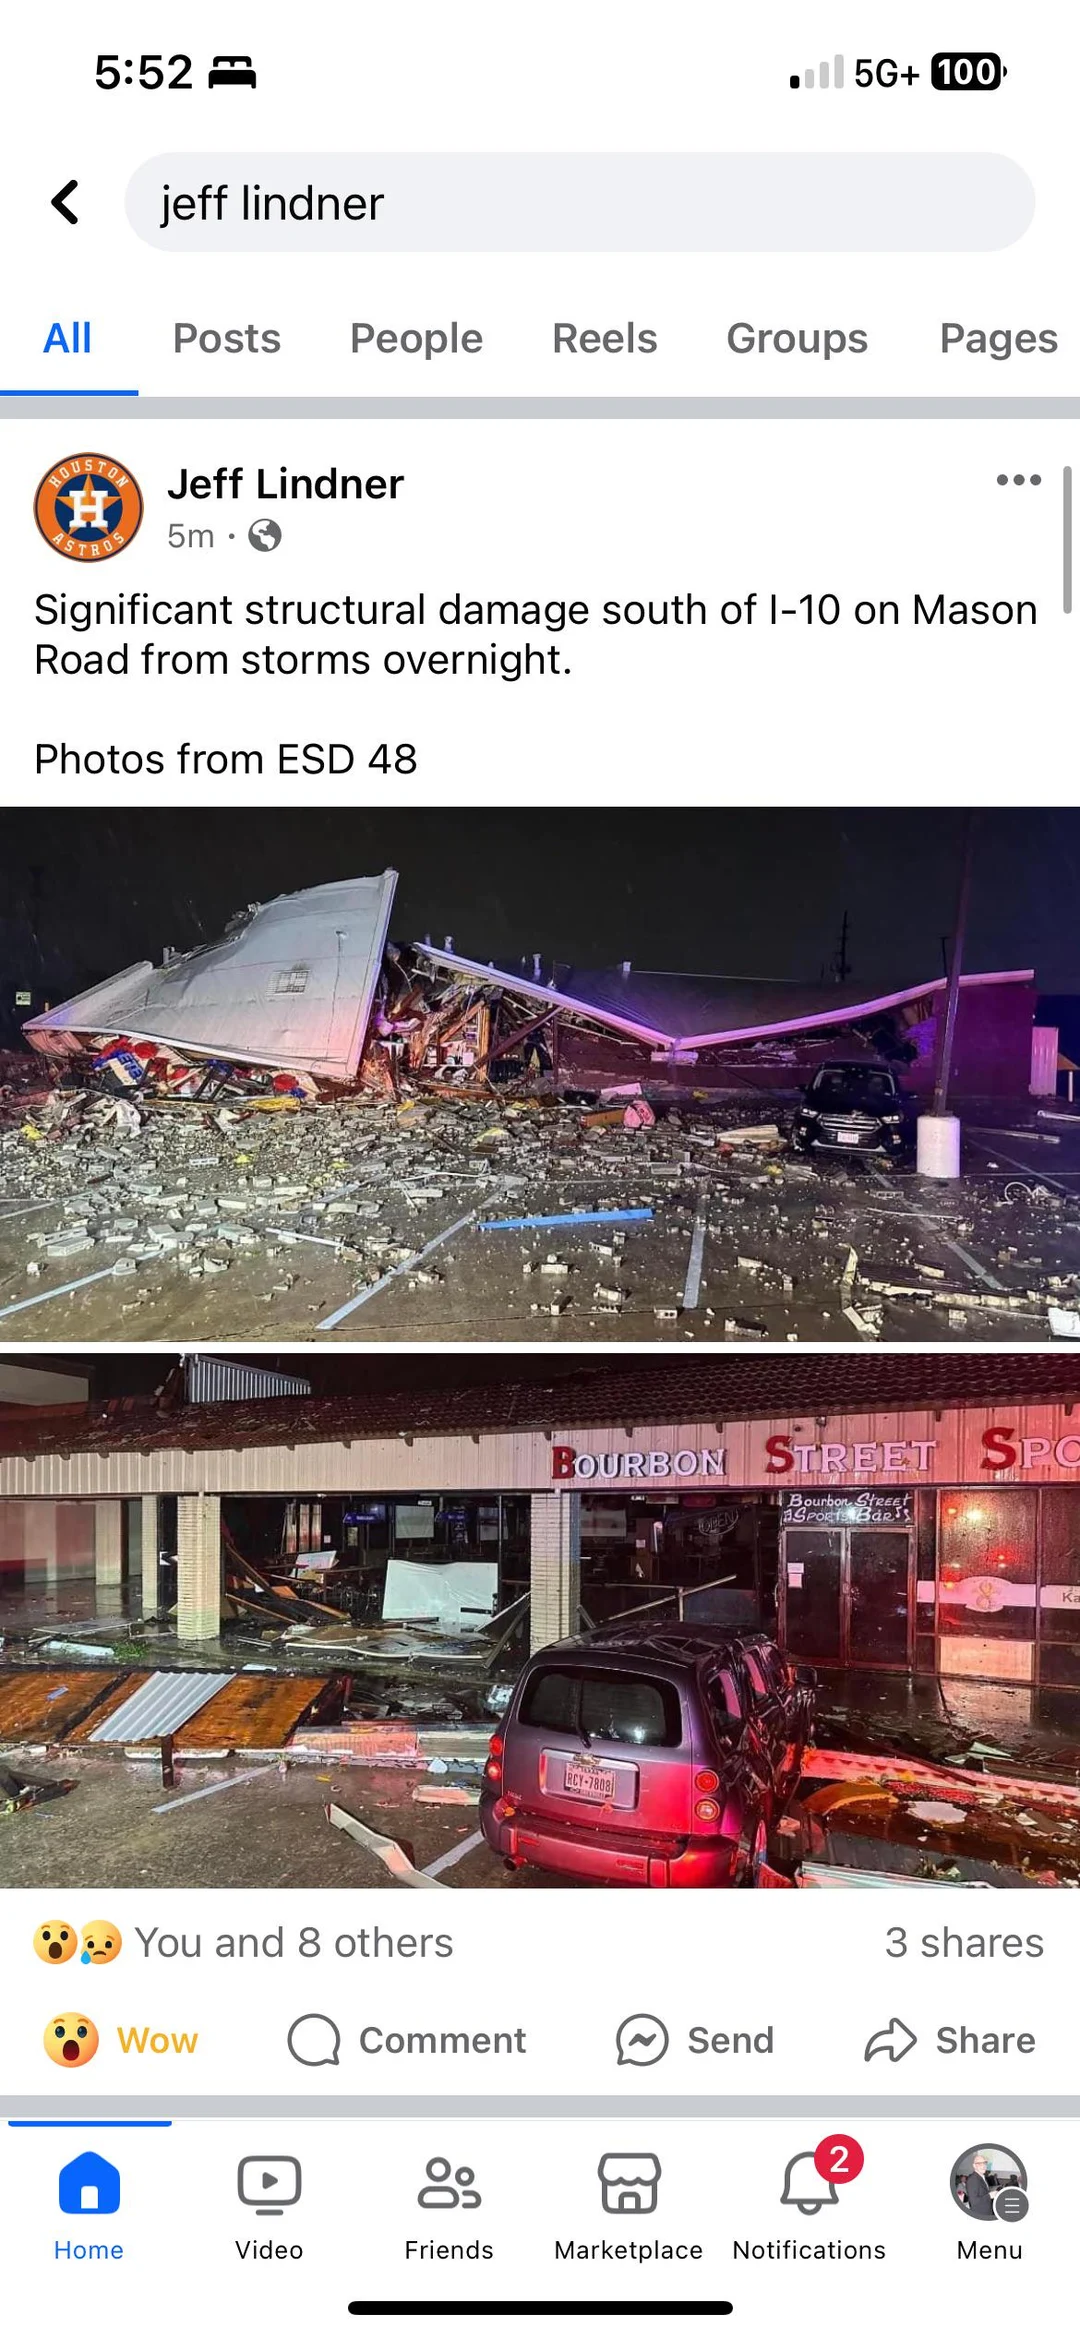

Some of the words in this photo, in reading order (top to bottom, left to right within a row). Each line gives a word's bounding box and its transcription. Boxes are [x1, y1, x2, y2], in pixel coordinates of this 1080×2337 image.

[96, 54, 193, 91] 5:52
[855, 58, 920, 89] 5G+
[937, 57, 996, 85] 100
[160, 184, 229, 229] jeff
[243, 184, 385, 221] lindner
[43, 321, 91, 354] All
[174, 322, 281, 354] Posts
[351, 321, 483, 361] People
[554, 322, 658, 354] Reels
[727, 321, 868, 361] Groups
[941, 322, 1059, 361] Pages
[48, 459, 129, 489] HOUSTON
[167, 466, 244, 500] Jeff
[257, 465, 405, 500] Lindner
[69, 490, 109, 528] H
[52, 532, 125, 557] ASTROS
[168, 523, 214, 549] 5m
[34, 592, 233, 633] Significant
[245, 592, 425, 626] structural
[438, 592, 590, 633] damage
[602, 592, 707, 626] south
[720, 592, 758, 626] of
[770, 593, 841, 626] I-10
[854, 600, 899, 626] on
[913, 593, 1037, 626] Mason
[36, 642, 129, 675] Road
[140, 642, 228, 675] from
[241, 645, 371, 675] storms
[383, 642, 571, 683] overnight.
[36, 742, 165, 775] Photos
[176, 741, 263, 775] from
[278, 742, 355, 775] ESD
[367, 742, 418, 775] 48
[552, 1445, 727, 1479] BOURBON
[765, 1434, 937, 1474] STREET
[134, 1926, 201, 1958] You
[215, 1925, 284, 1958] and
[298, 1926, 321, 1958] 8
[334, 1925, 453, 1958] others
[885, 1926, 908, 1958] 3
[921, 1925, 1044, 1958] shares
[116, 2026, 199, 2054] Wow
[359, 2026, 527, 2055] Comment
[688, 2025, 774, 2055] Send
[936, 2025, 1036, 2055] Share
[830, 2145, 849, 2173] 2
[54, 2240, 124, 2260] Home
[234, 2239, 304, 2260] Video
[405, 2239, 494, 2260] Friends
[555, 2239, 703, 2264] Marketplace
[733, 2239, 886, 2260] Notifications
[957, 2240, 1022, 2260] Menu
